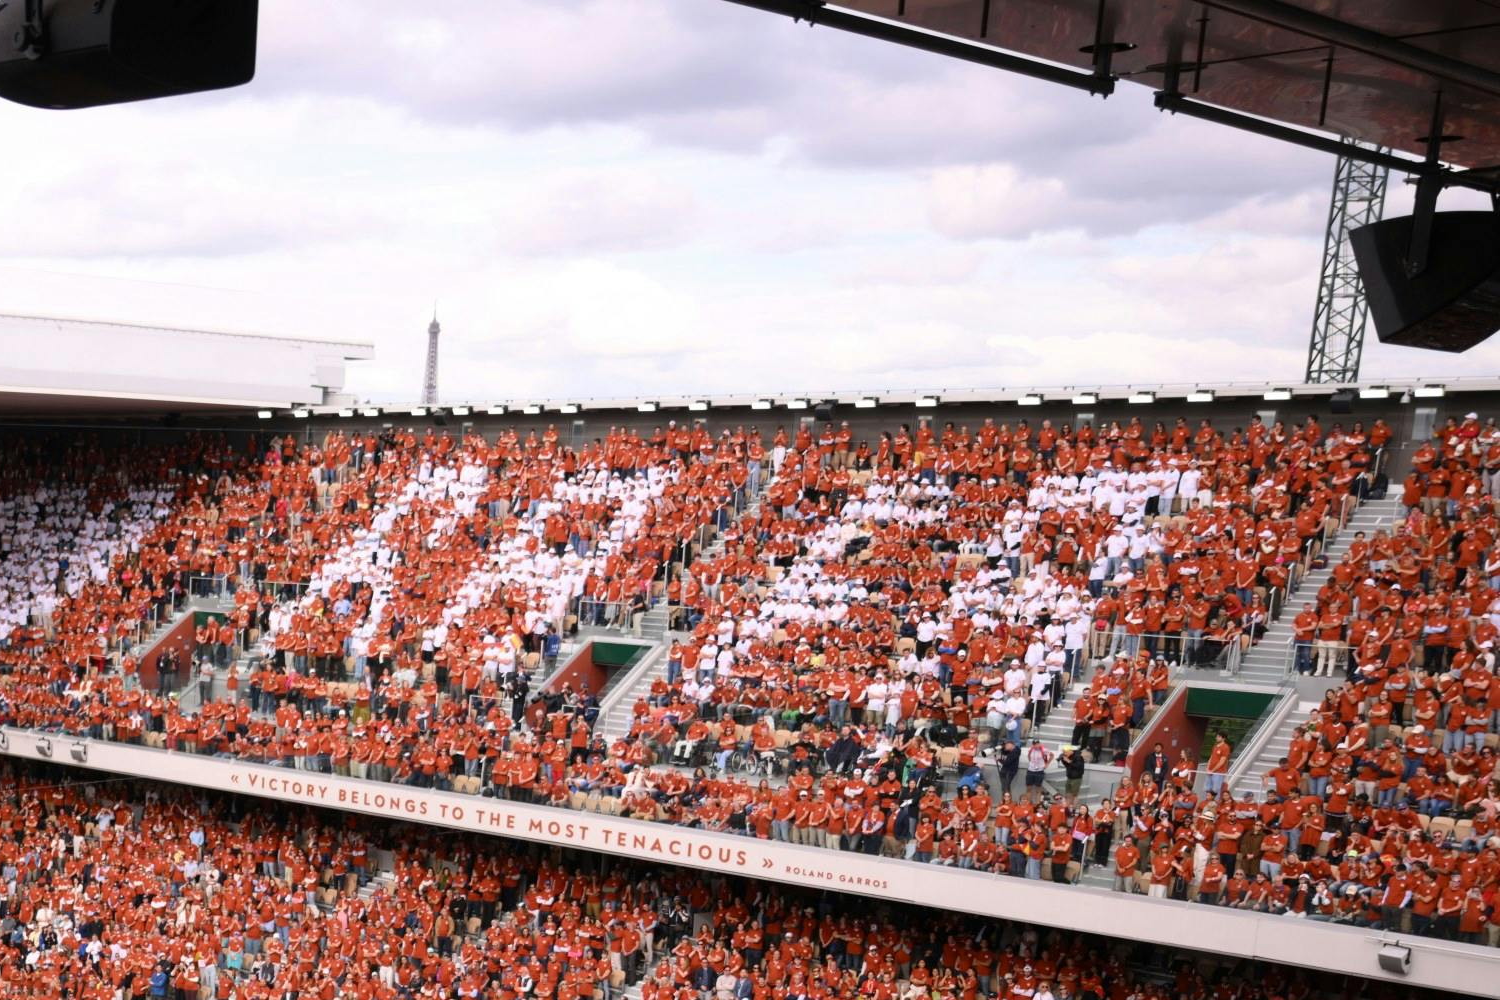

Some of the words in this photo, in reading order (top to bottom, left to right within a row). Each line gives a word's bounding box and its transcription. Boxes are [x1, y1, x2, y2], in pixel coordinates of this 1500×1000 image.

[248, 773, 328, 799] VICTORY
[338, 789, 428, 814] BELONGS
[439, 804, 464, 820] TO
[476, 810, 515, 829] THE
[528, 818, 590, 841] MOST
[602, 829, 747, 866] TENACIOUS
[785, 865, 833, 880] ROLAND
[838, 874, 888, 889] GARROS
